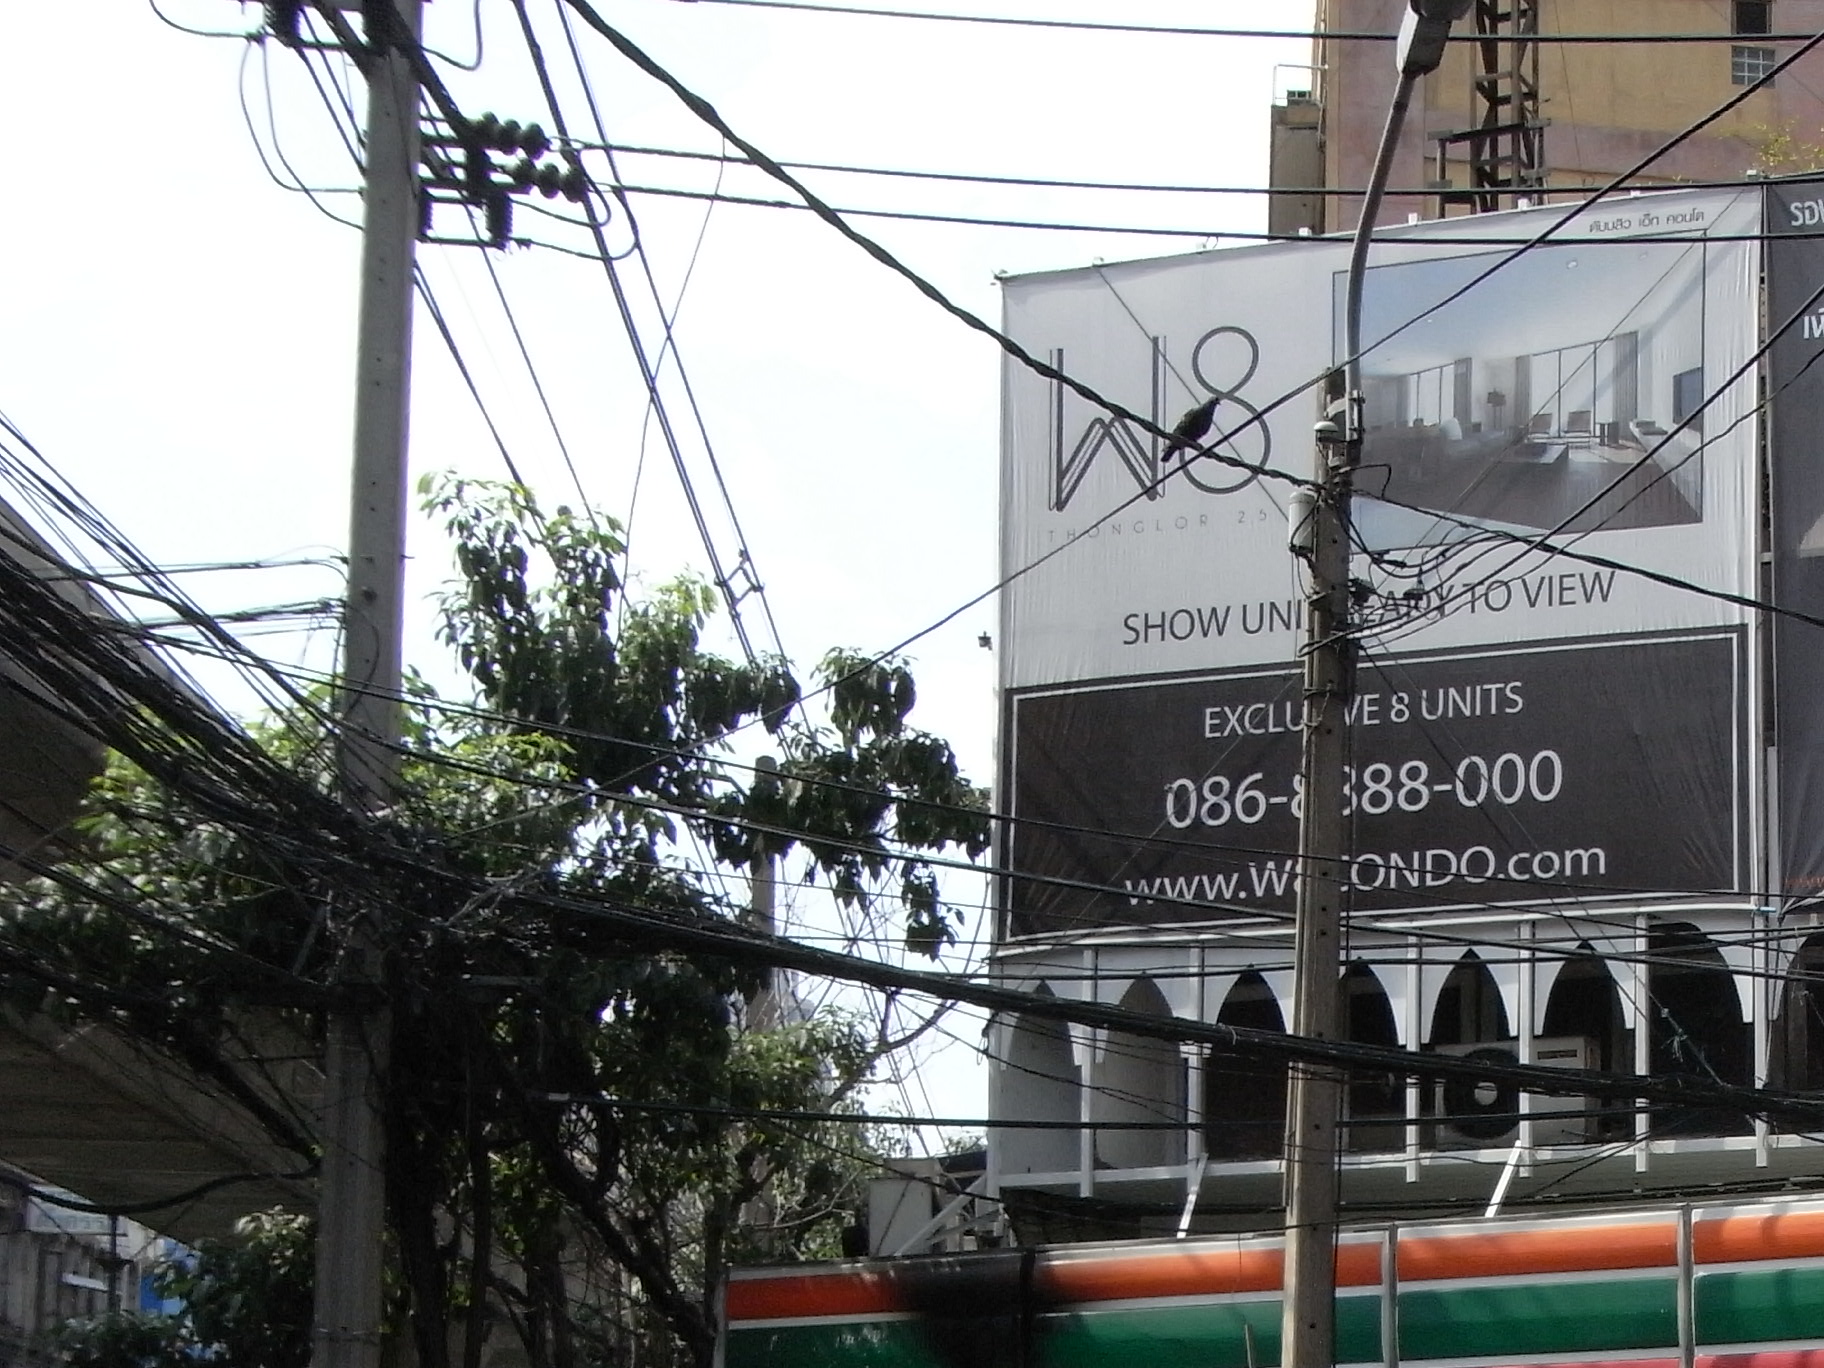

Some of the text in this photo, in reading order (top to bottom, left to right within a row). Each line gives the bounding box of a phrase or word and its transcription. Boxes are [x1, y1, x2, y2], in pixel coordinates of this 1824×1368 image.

[1123, 605, 1232, 646] SHOW
[1242, 599, 1312, 635] UNI
[1463, 579, 1513, 616] TO
[1521, 570, 1617, 608] VIEW
[1203, 680, 1524, 740] EXCLUVE 8 UNITS
[1125, 844, 1607, 907] www.WONDO.com
